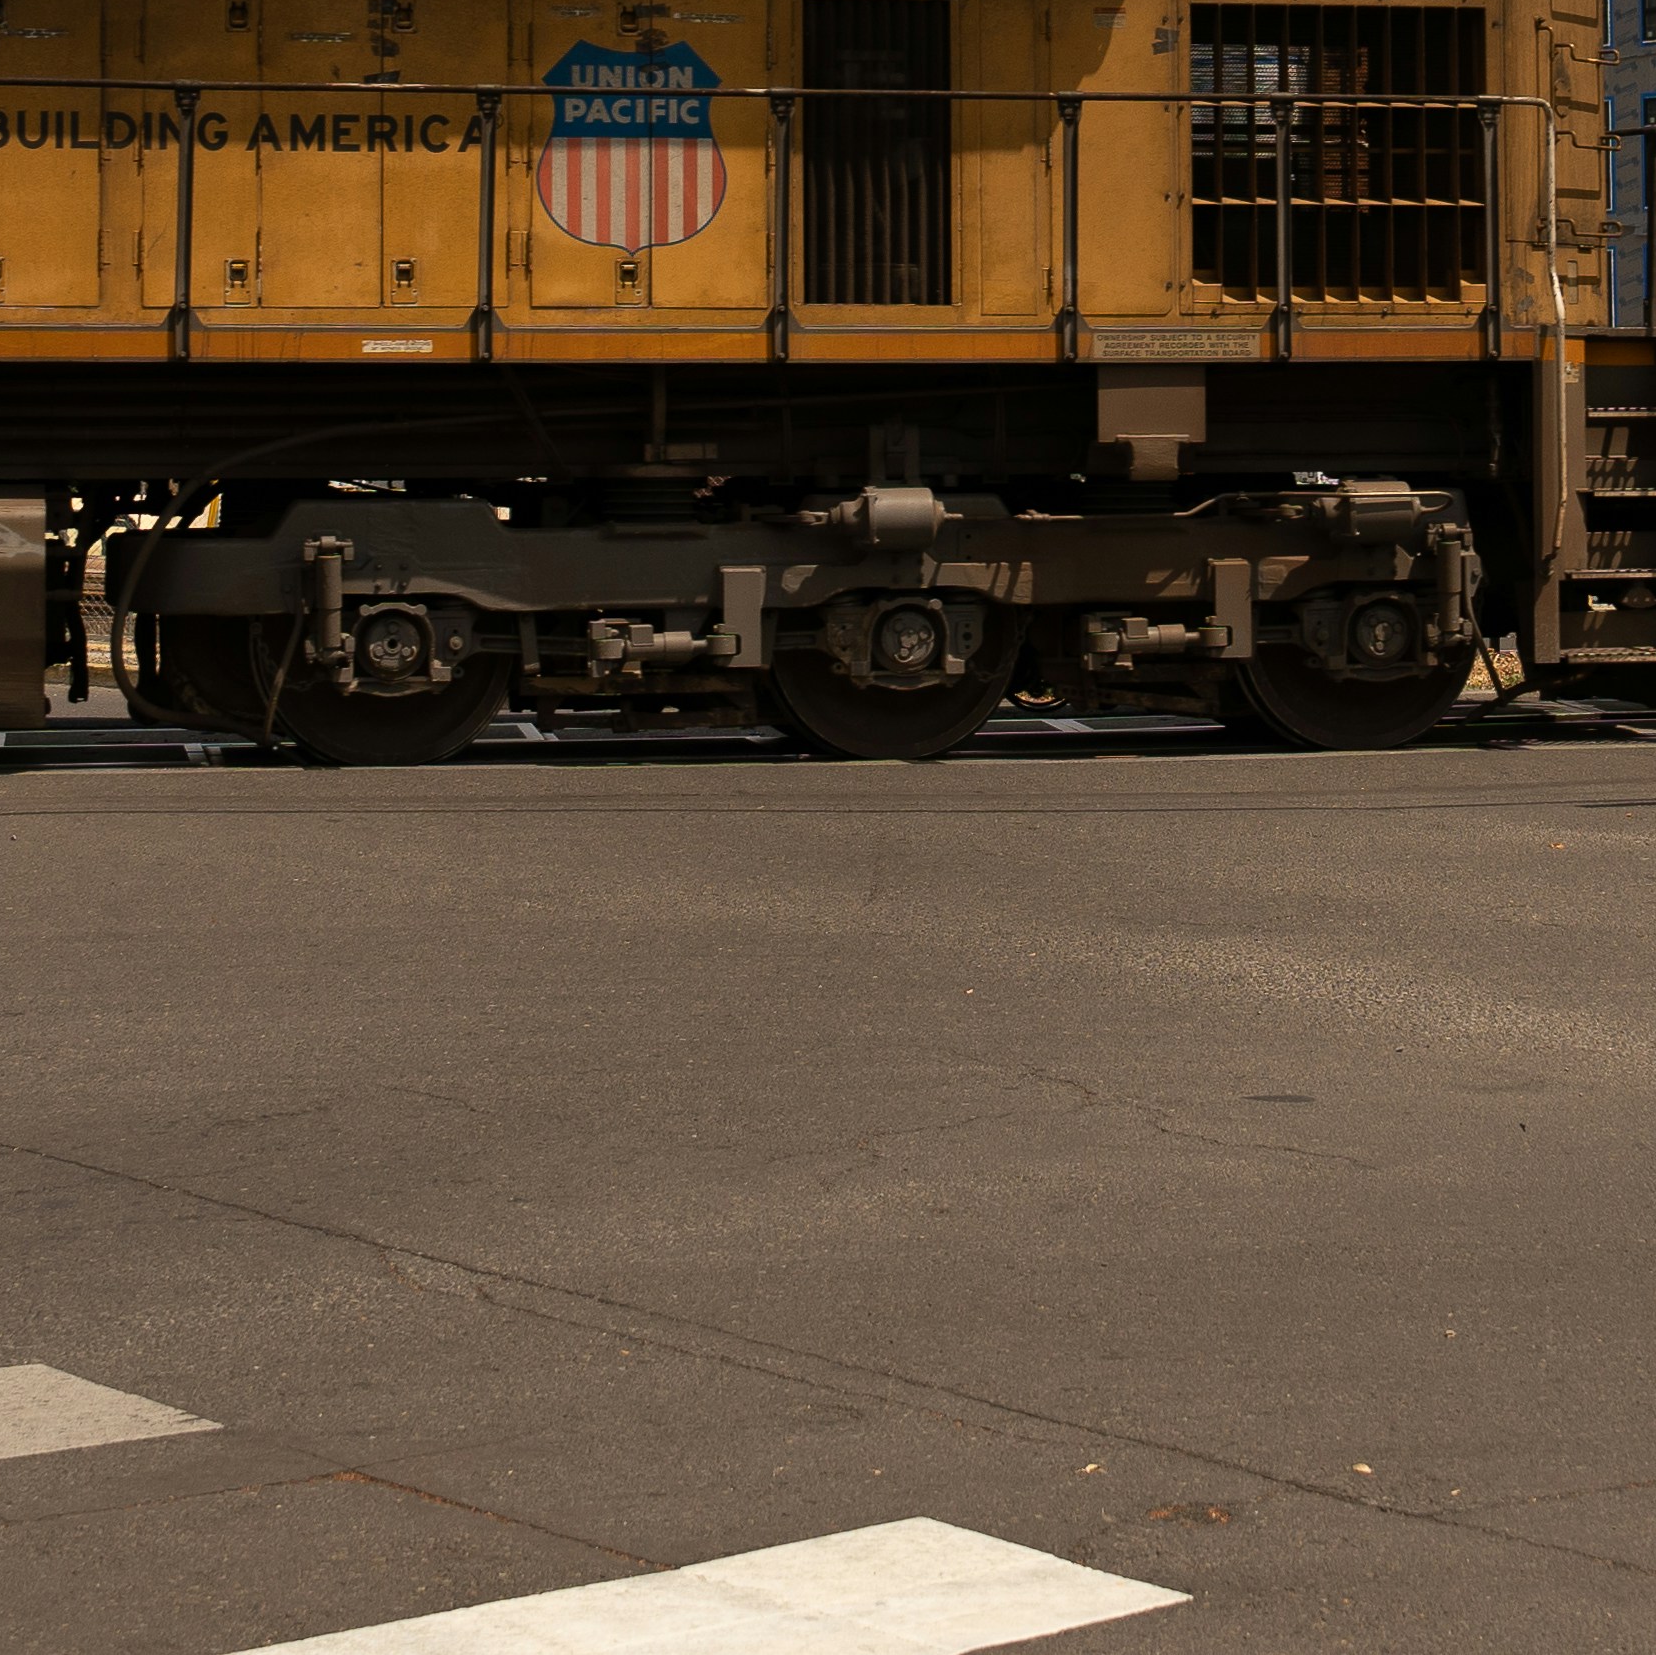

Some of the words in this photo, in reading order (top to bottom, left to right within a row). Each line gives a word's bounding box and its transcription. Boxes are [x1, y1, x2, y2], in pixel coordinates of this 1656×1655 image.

[571, 65, 693, 88] UNION
[564, 98, 700, 124] PACIFIC
[246, 113, 482, 154] AMERICA
[1097, 334, 1147, 342] OWNERSHIP
[1149, 334, 1187, 342] SUBJECT
[1191, 334, 1203, 342] TO
[1207, 334, 1213, 342] A
[1215, 334, 1257, 342] SECURITY
